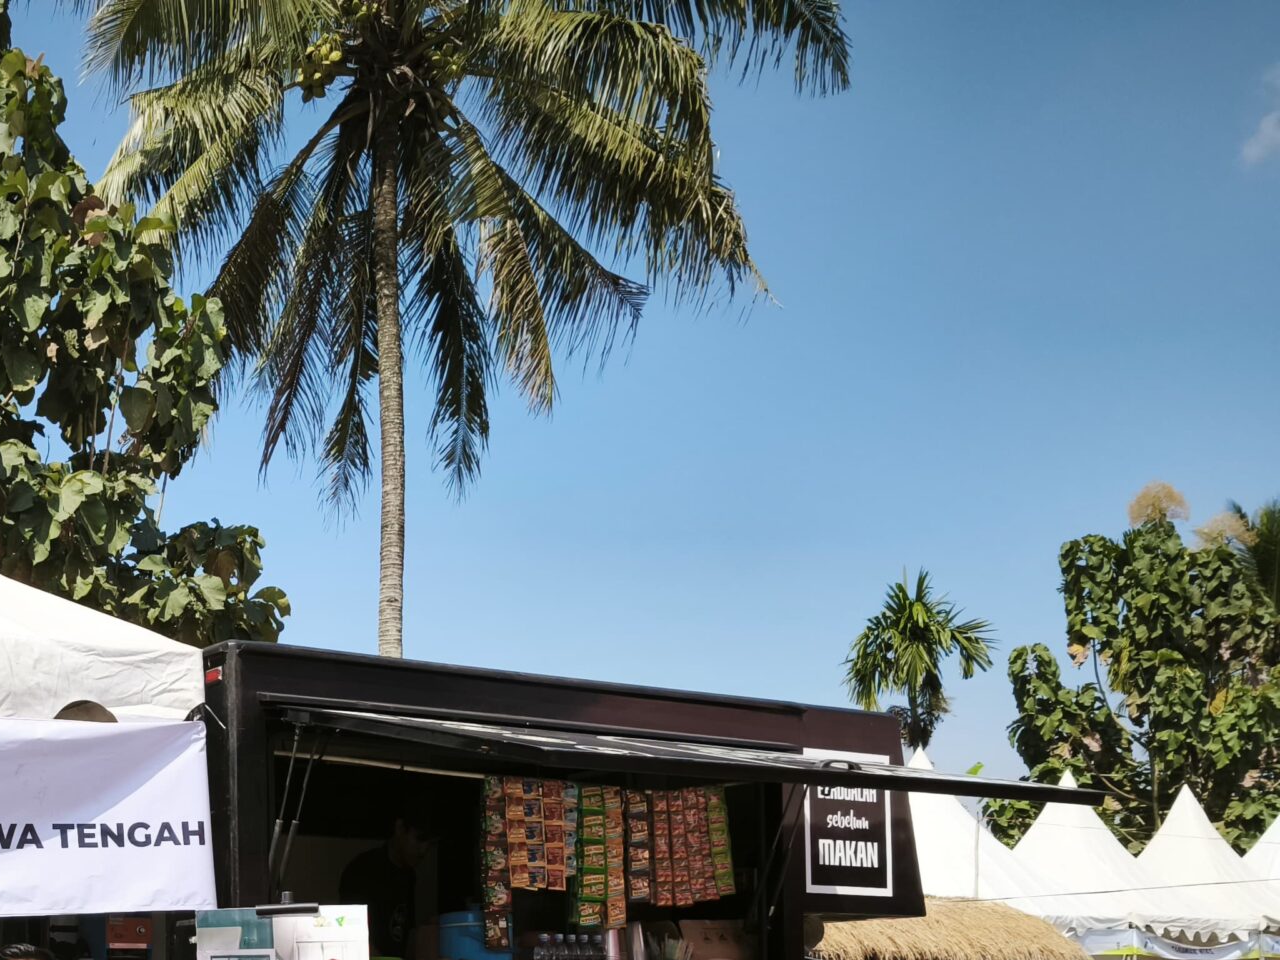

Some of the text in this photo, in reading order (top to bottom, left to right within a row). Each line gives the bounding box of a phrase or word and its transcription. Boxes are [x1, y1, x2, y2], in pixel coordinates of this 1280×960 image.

[51, 820, 207, 850] TENGAH
[827, 809, 870, 831] sebelum
[818, 838, 879, 868] MAKAN
